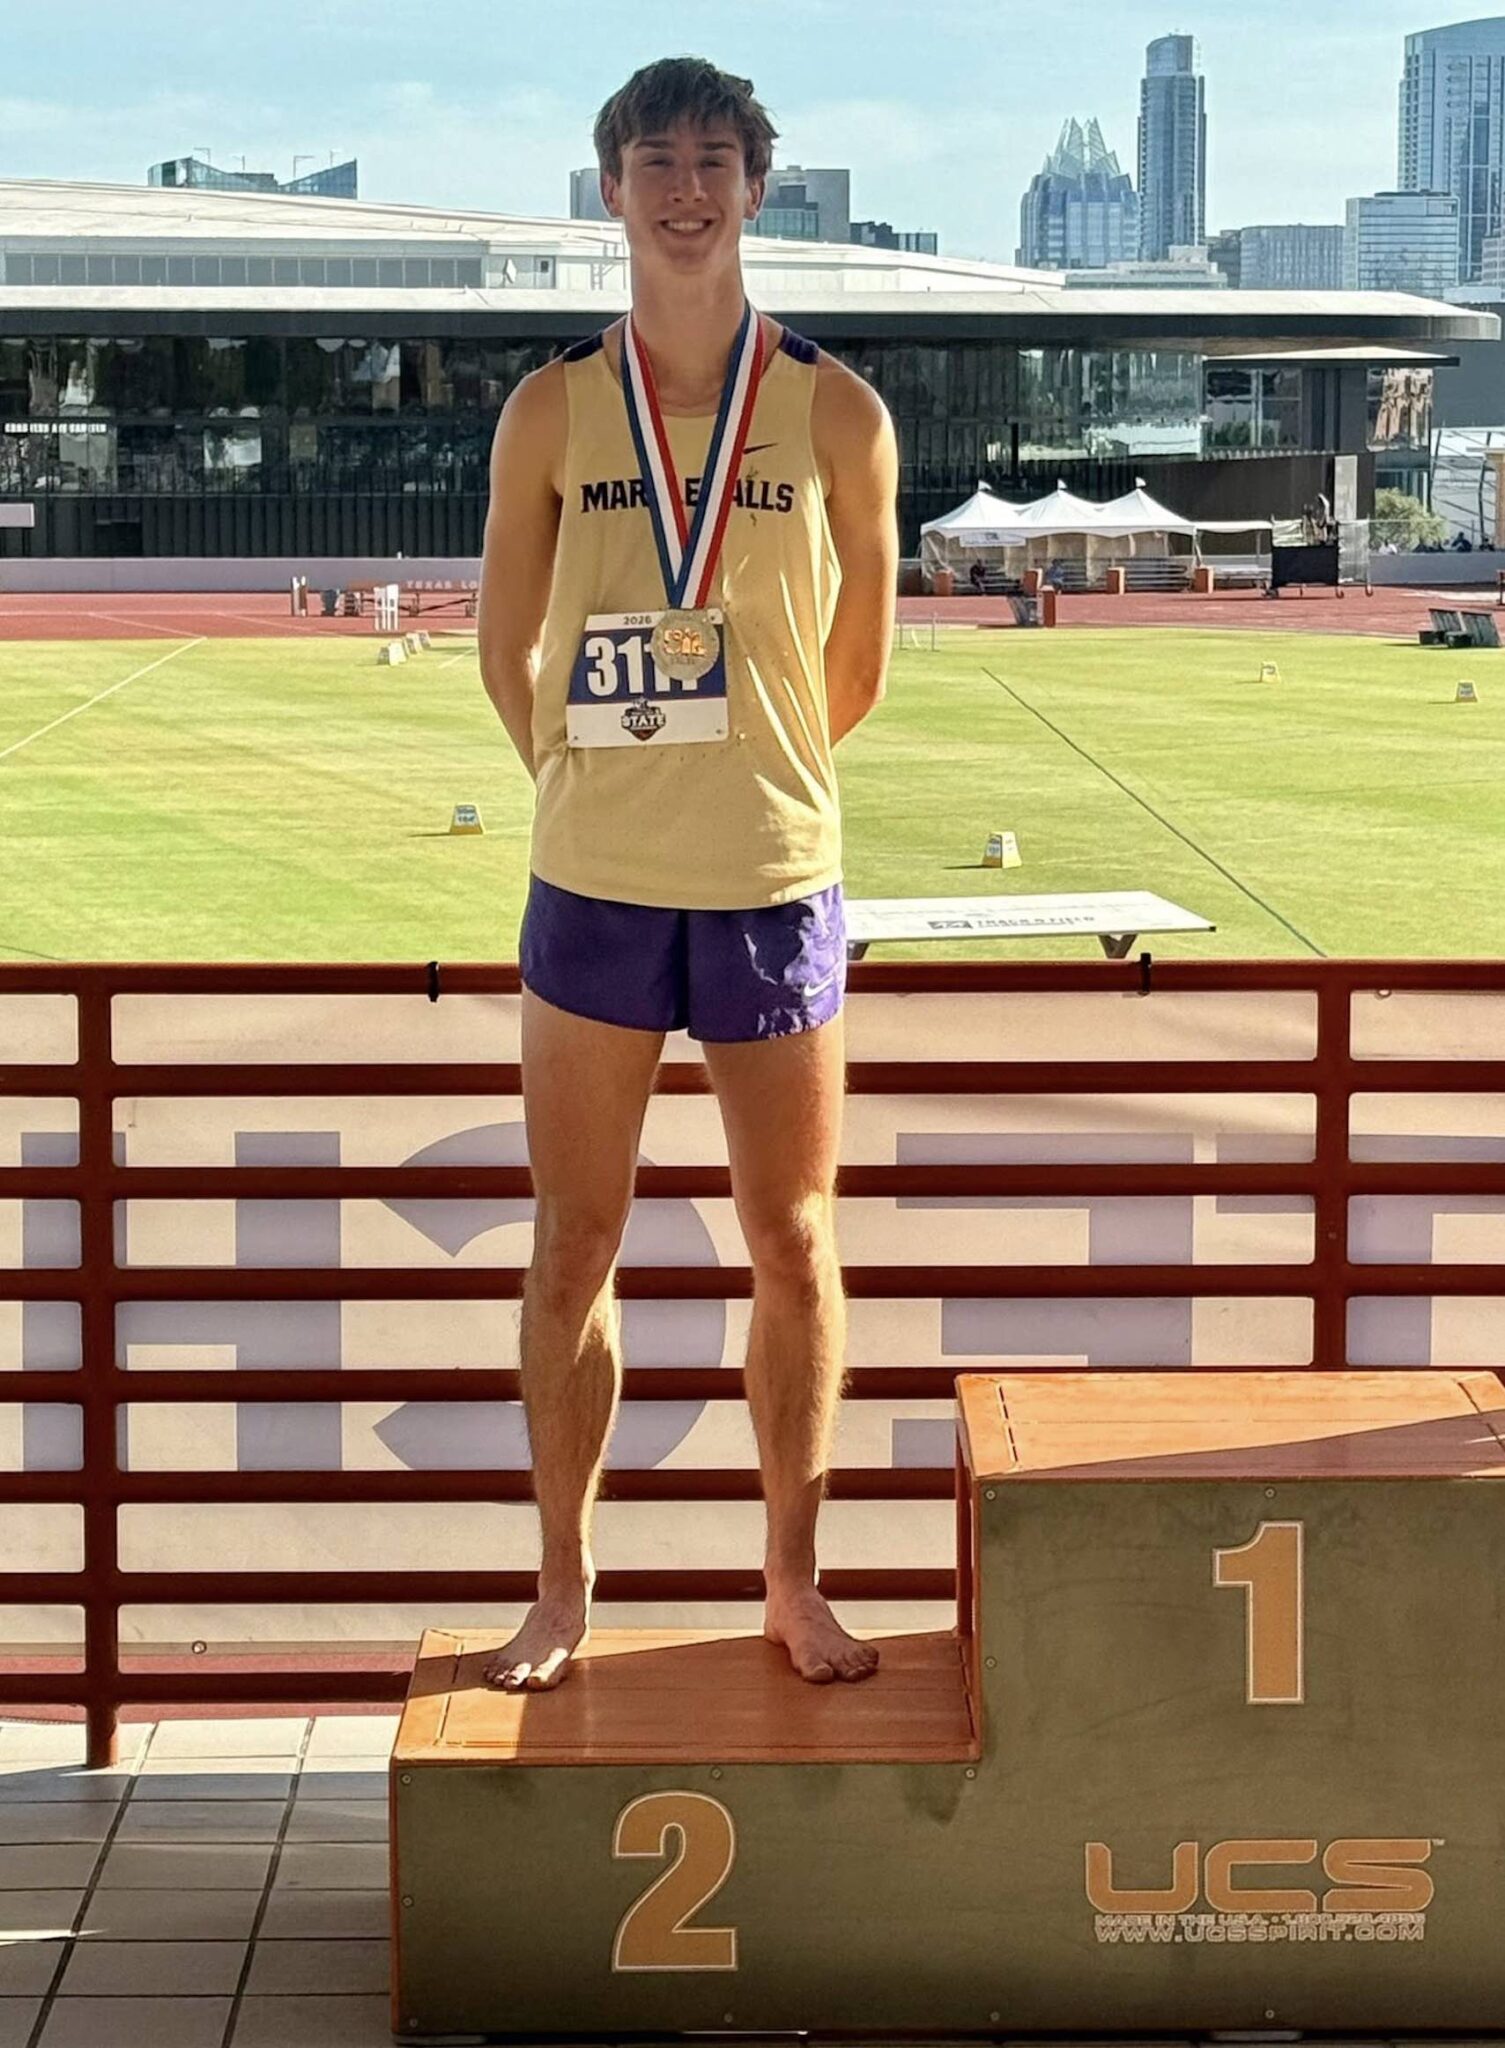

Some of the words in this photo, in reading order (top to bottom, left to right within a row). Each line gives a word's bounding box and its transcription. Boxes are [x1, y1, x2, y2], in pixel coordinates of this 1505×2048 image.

[581, 478, 701, 513] MARE
[732, 479, 795, 514] ALLS
[623, 615, 652, 625] 2026
[621, 713, 665, 727] STATE
[1212, 1519, 1306, 1707] 1
[612, 1789, 738, 1973] 2
[1085, 1838, 1435, 1912] UCS
[1095, 1924, 1426, 1943] WWW.UCSSPIRIT.COM
